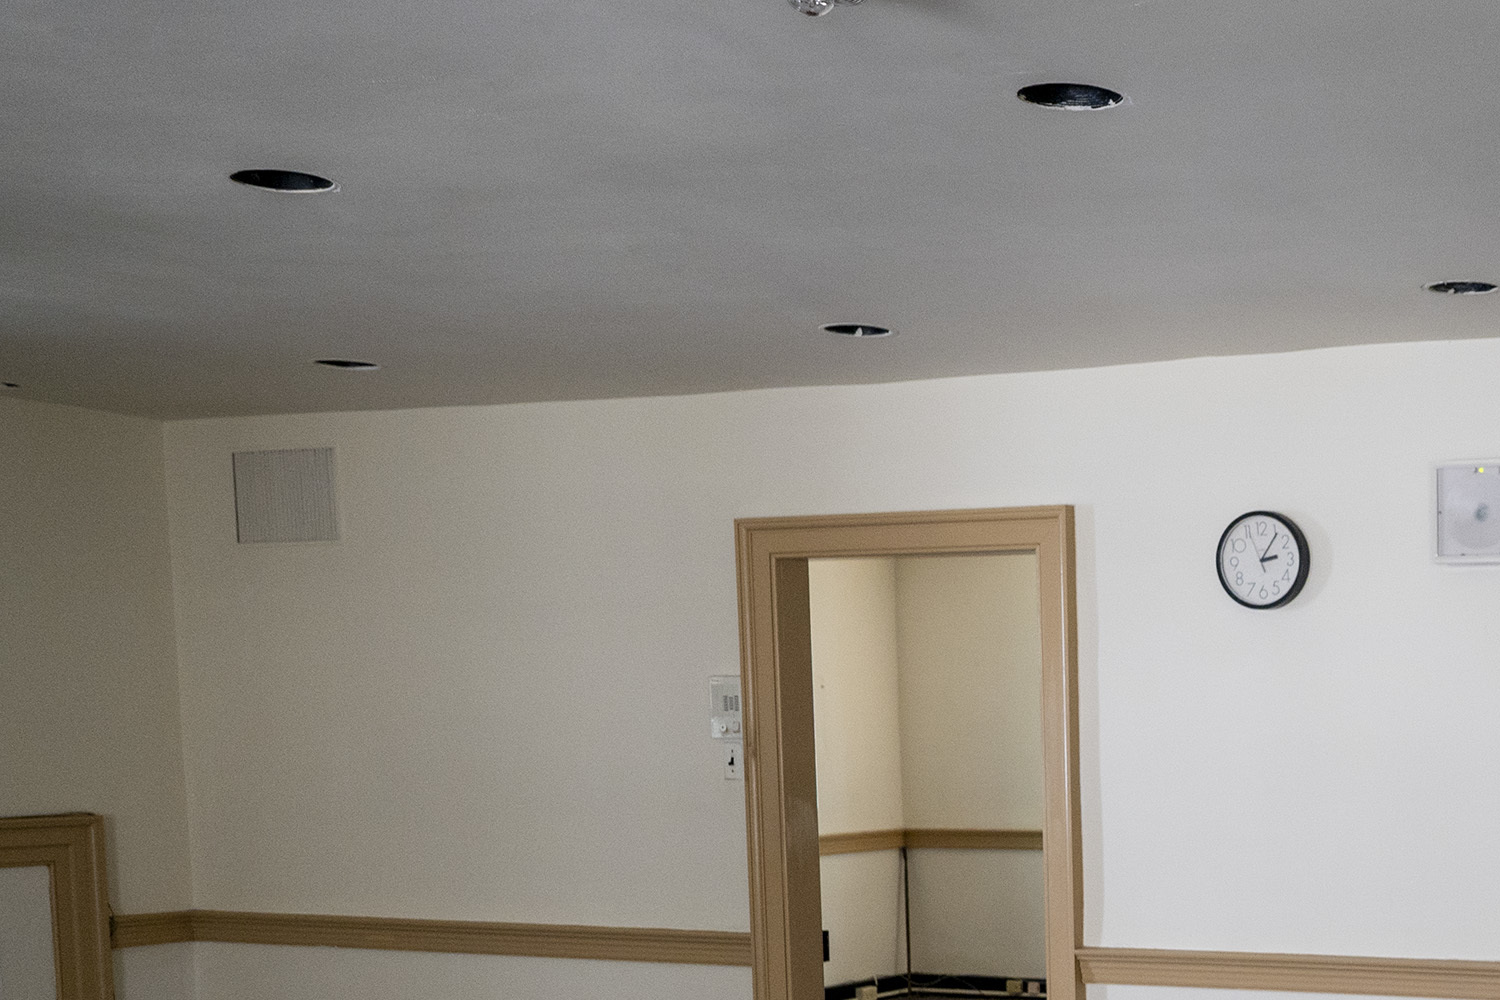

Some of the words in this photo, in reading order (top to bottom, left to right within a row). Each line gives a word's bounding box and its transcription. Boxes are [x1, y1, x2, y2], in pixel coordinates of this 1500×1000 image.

[1256, 521, 1267, 536] 12
[1231, 538, 1246, 553] 10
[1282, 535, 1289, 549] 2
[1230, 556, 1239, 570] 9
[1287, 552, 1294, 567] 3
[1236, 571, 1244, 586] 8
[1282, 569, 1291, 582] 4
[1246, 583, 1256, 597] 7
[1259, 585, 1268, 600] 6
[1272, 580, 1281, 596] 5
